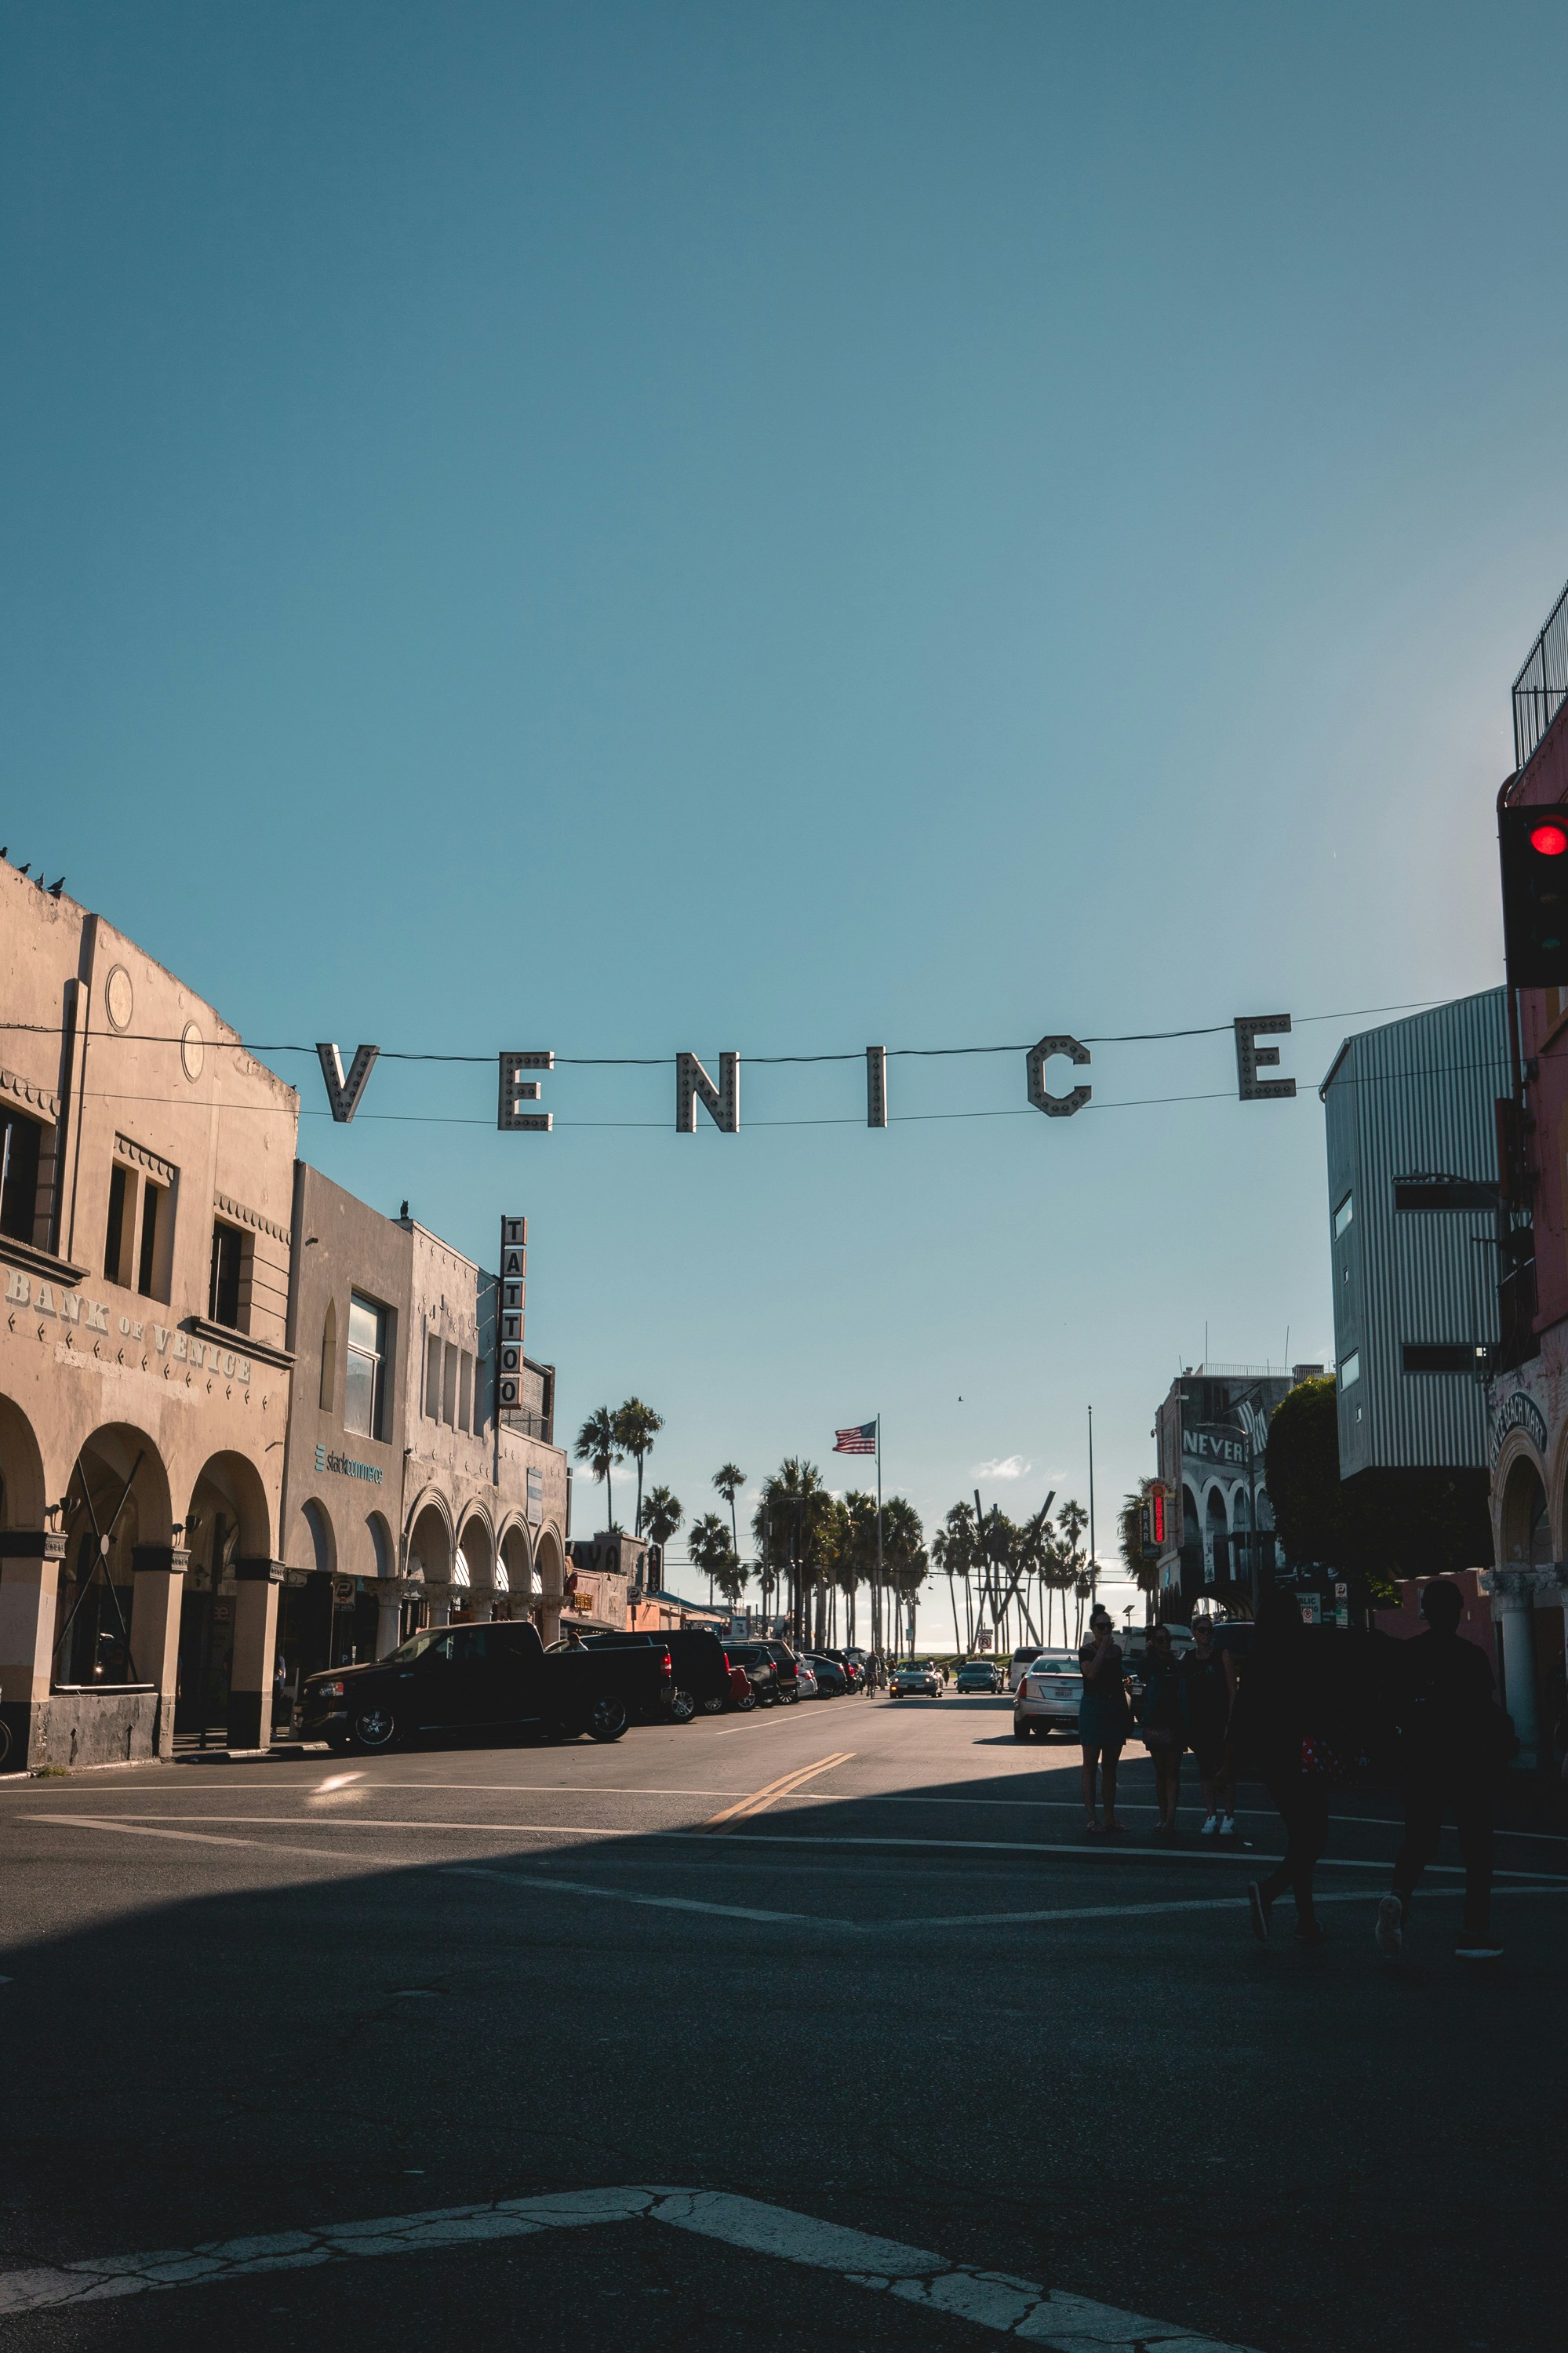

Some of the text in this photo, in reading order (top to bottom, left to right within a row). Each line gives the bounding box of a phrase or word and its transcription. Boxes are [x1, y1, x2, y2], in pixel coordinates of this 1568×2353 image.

[315, 1014, 1296, 1132] VENICE
[5, 1268, 252, 1384] BANK OF VENICE
[501, 1220, 521, 1401] TATTOO
[1183, 1430, 1242, 1462] NEVER
[1502, 1396, 1523, 1430] BEACH
[1525, 1399, 1544, 1450] MART
[326, 1450, 383, 1485] stackcommerce
